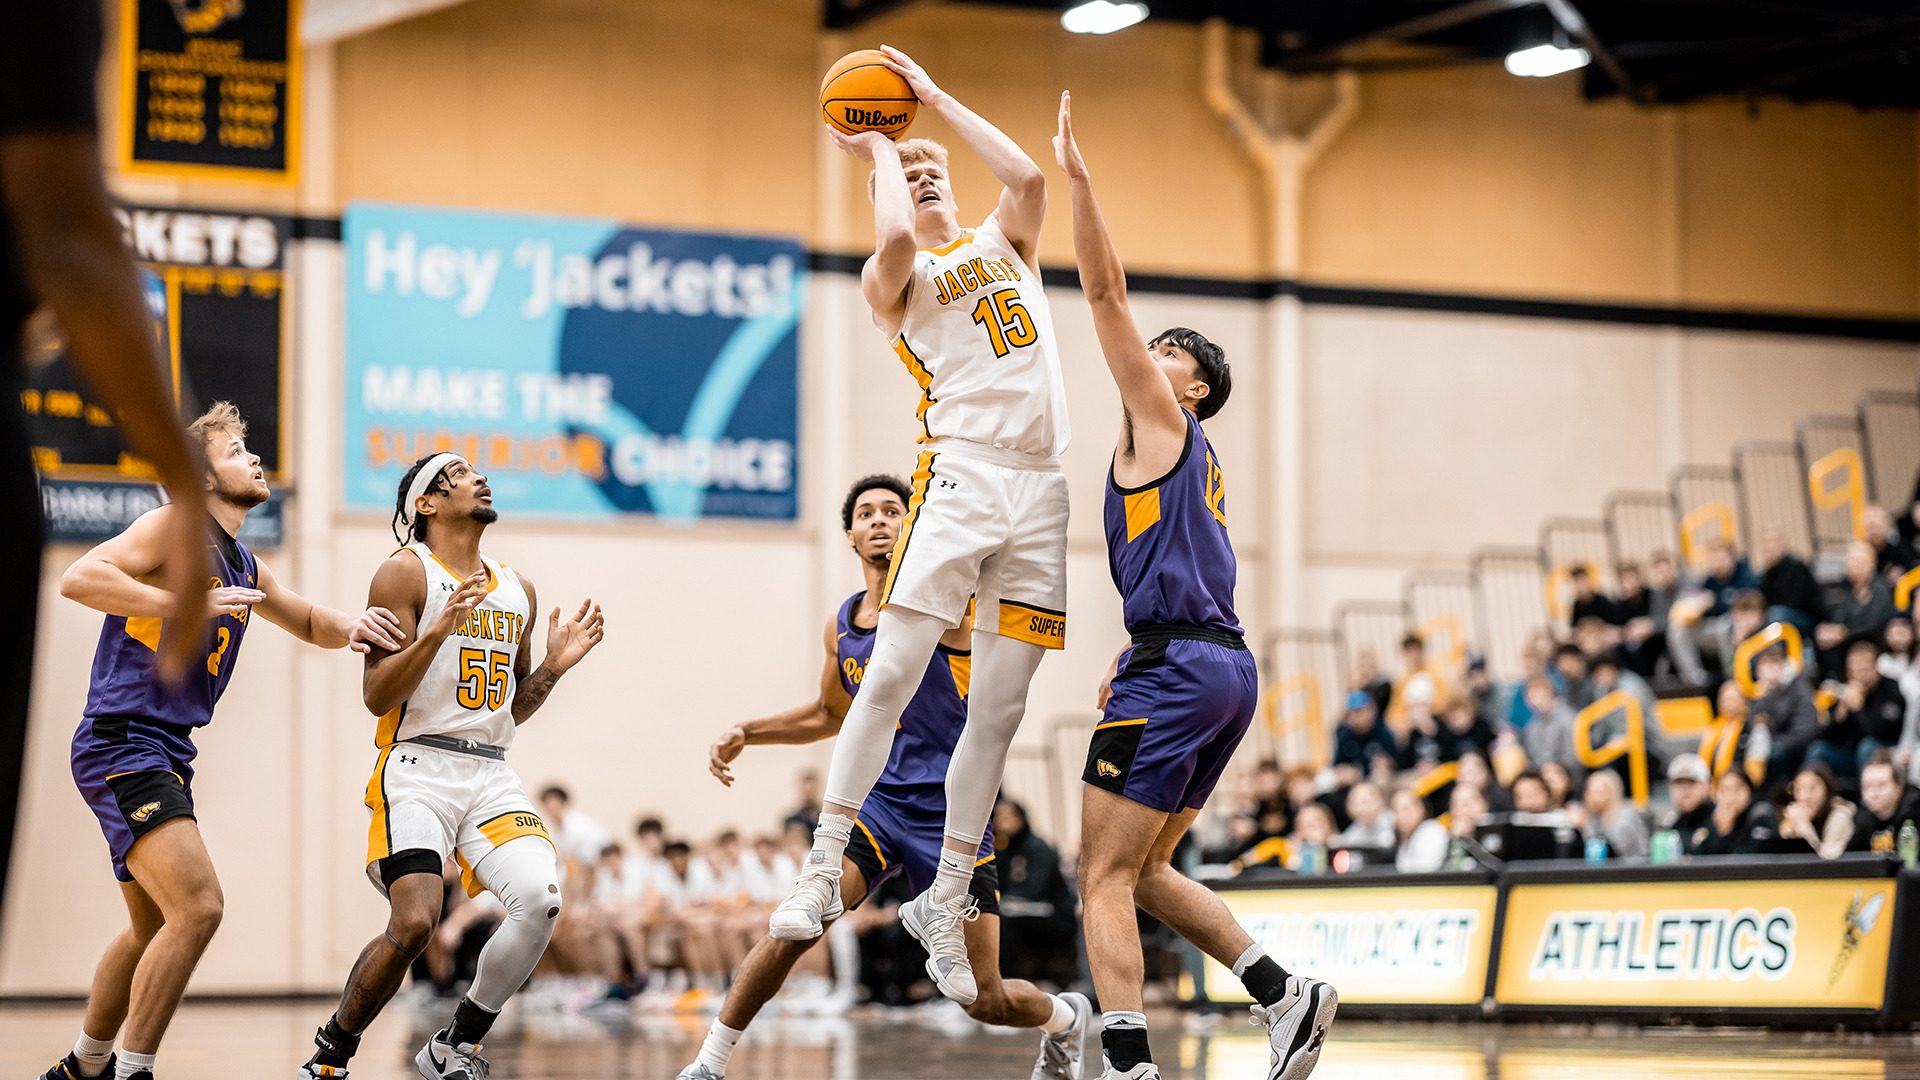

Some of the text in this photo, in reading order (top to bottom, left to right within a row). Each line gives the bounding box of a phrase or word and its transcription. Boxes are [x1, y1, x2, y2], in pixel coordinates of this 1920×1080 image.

[844, 107, 909, 127] Wilson
[364, 228, 502, 318] Hey
[933, 256, 1022, 306] JACKETS
[971, 288, 1039, 360] 15
[363, 364, 613, 424] MAKE THE
[364, 426, 796, 492] SUPERIOR CHOICE
[450, 608, 524, 645] ACKETS
[1029, 615, 1065, 638] SUPER
[456, 646, 511, 712] 55
[1533, 914, 1793, 973] ATHLETICS
